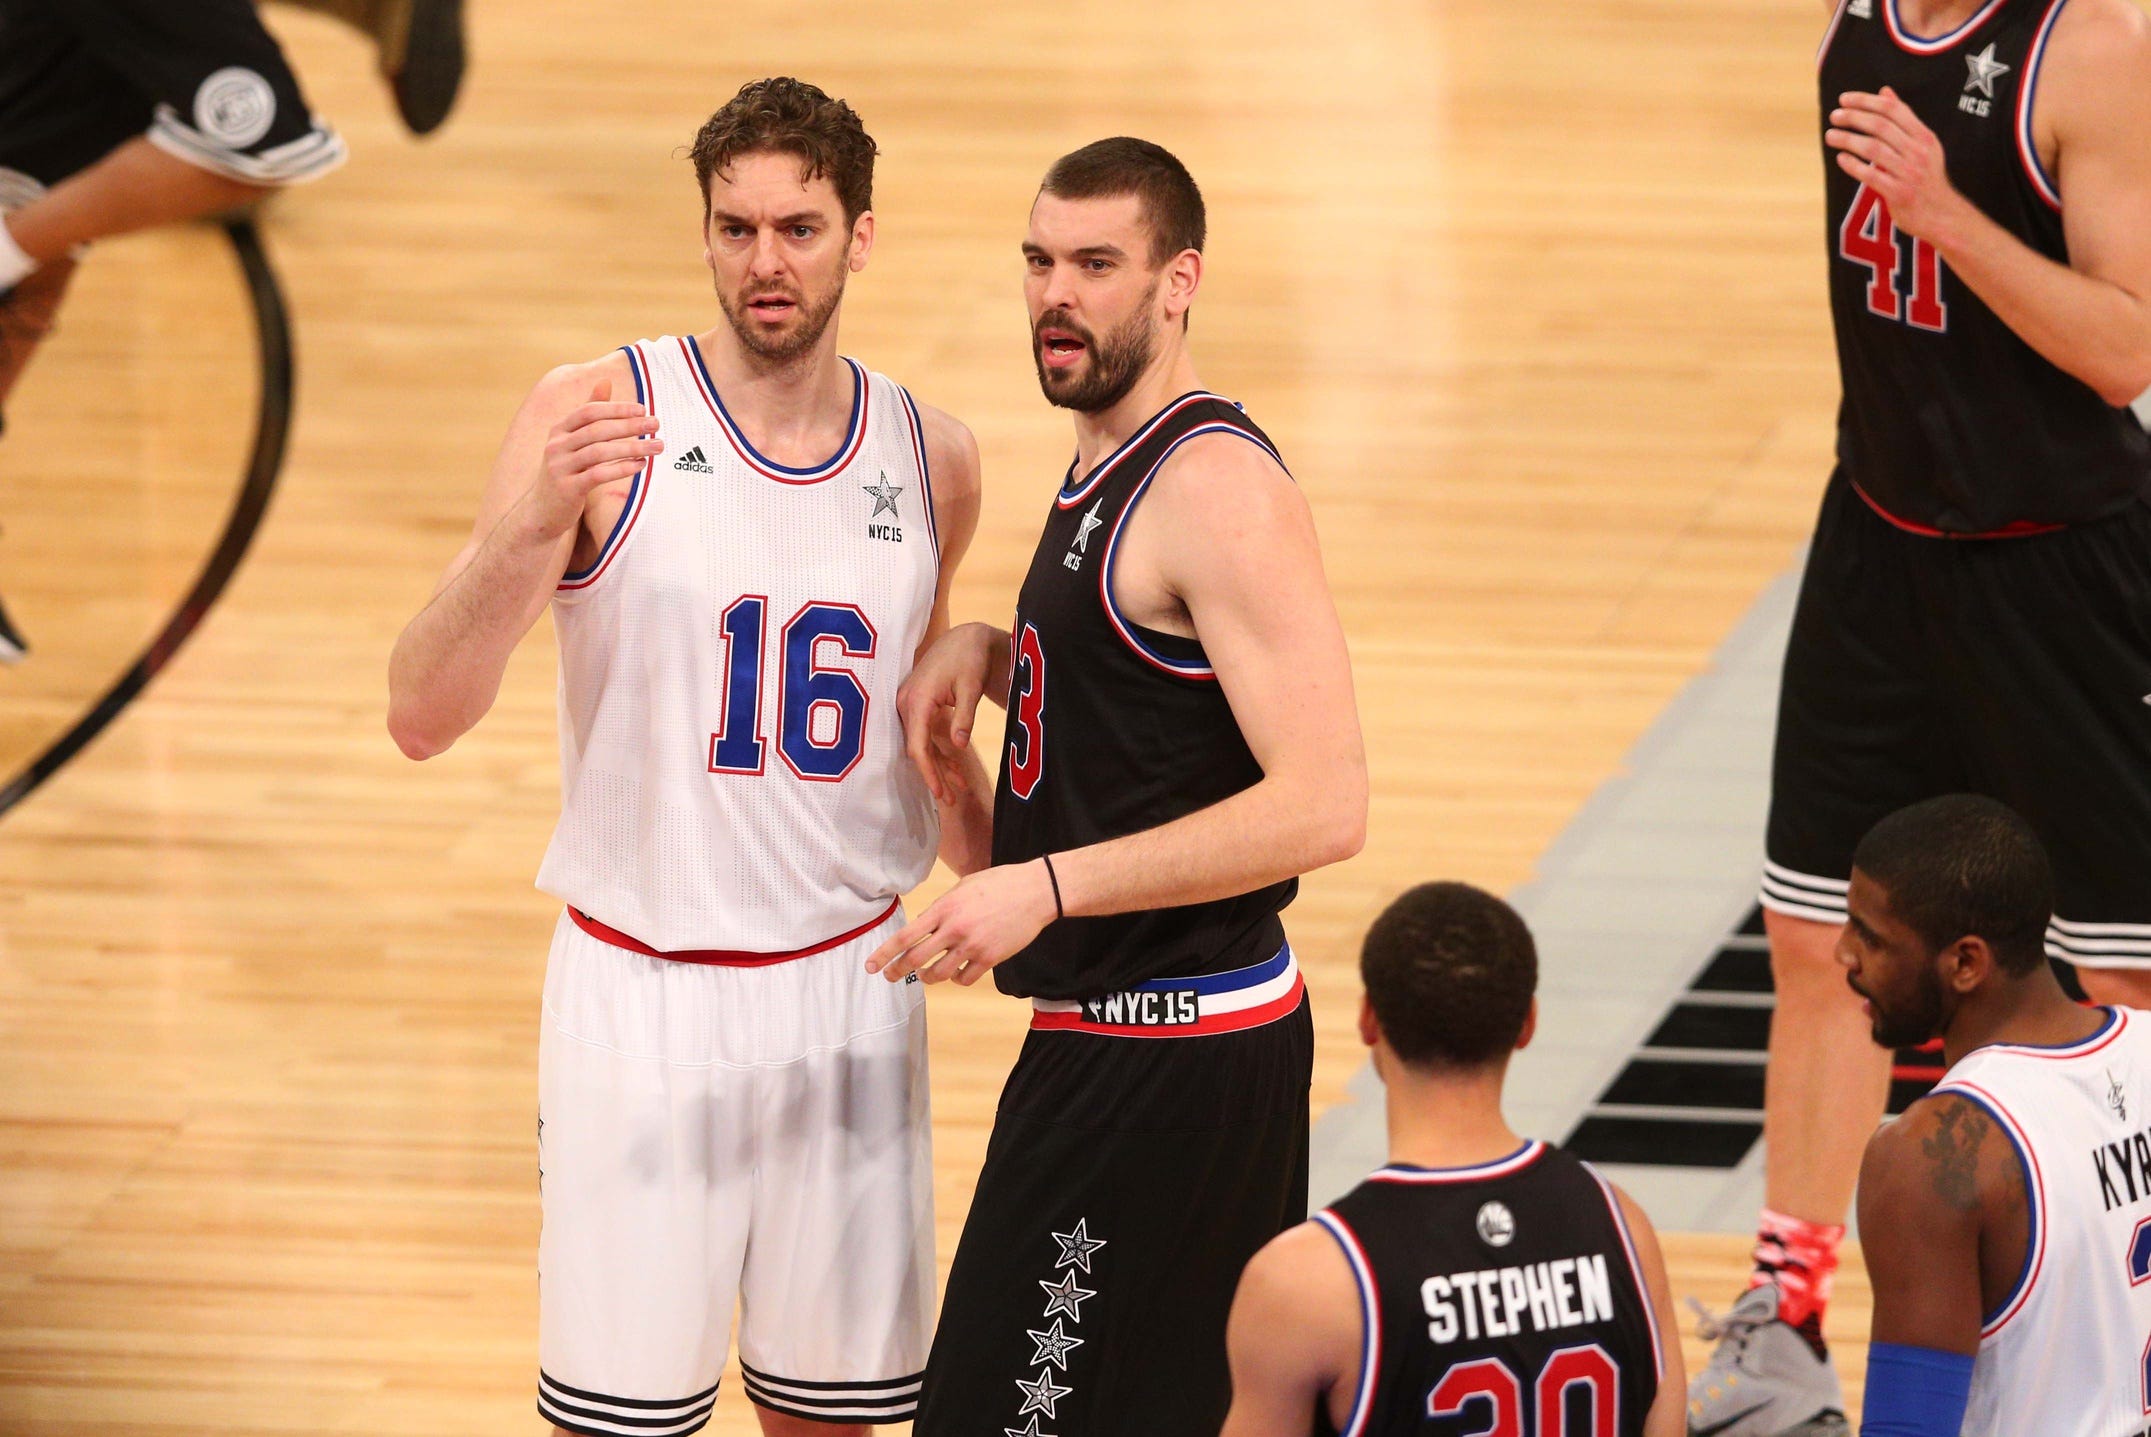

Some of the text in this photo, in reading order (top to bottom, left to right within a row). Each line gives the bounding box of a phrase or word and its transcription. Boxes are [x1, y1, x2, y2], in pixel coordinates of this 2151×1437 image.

[1840, 162, 1947, 333] 41
[674, 461, 714, 474] adidas
[707, 593, 878, 783] 16
[2092, 1126, 2151, 1213] KYR
[1420, 1254, 1615, 1345] STEPHEN
